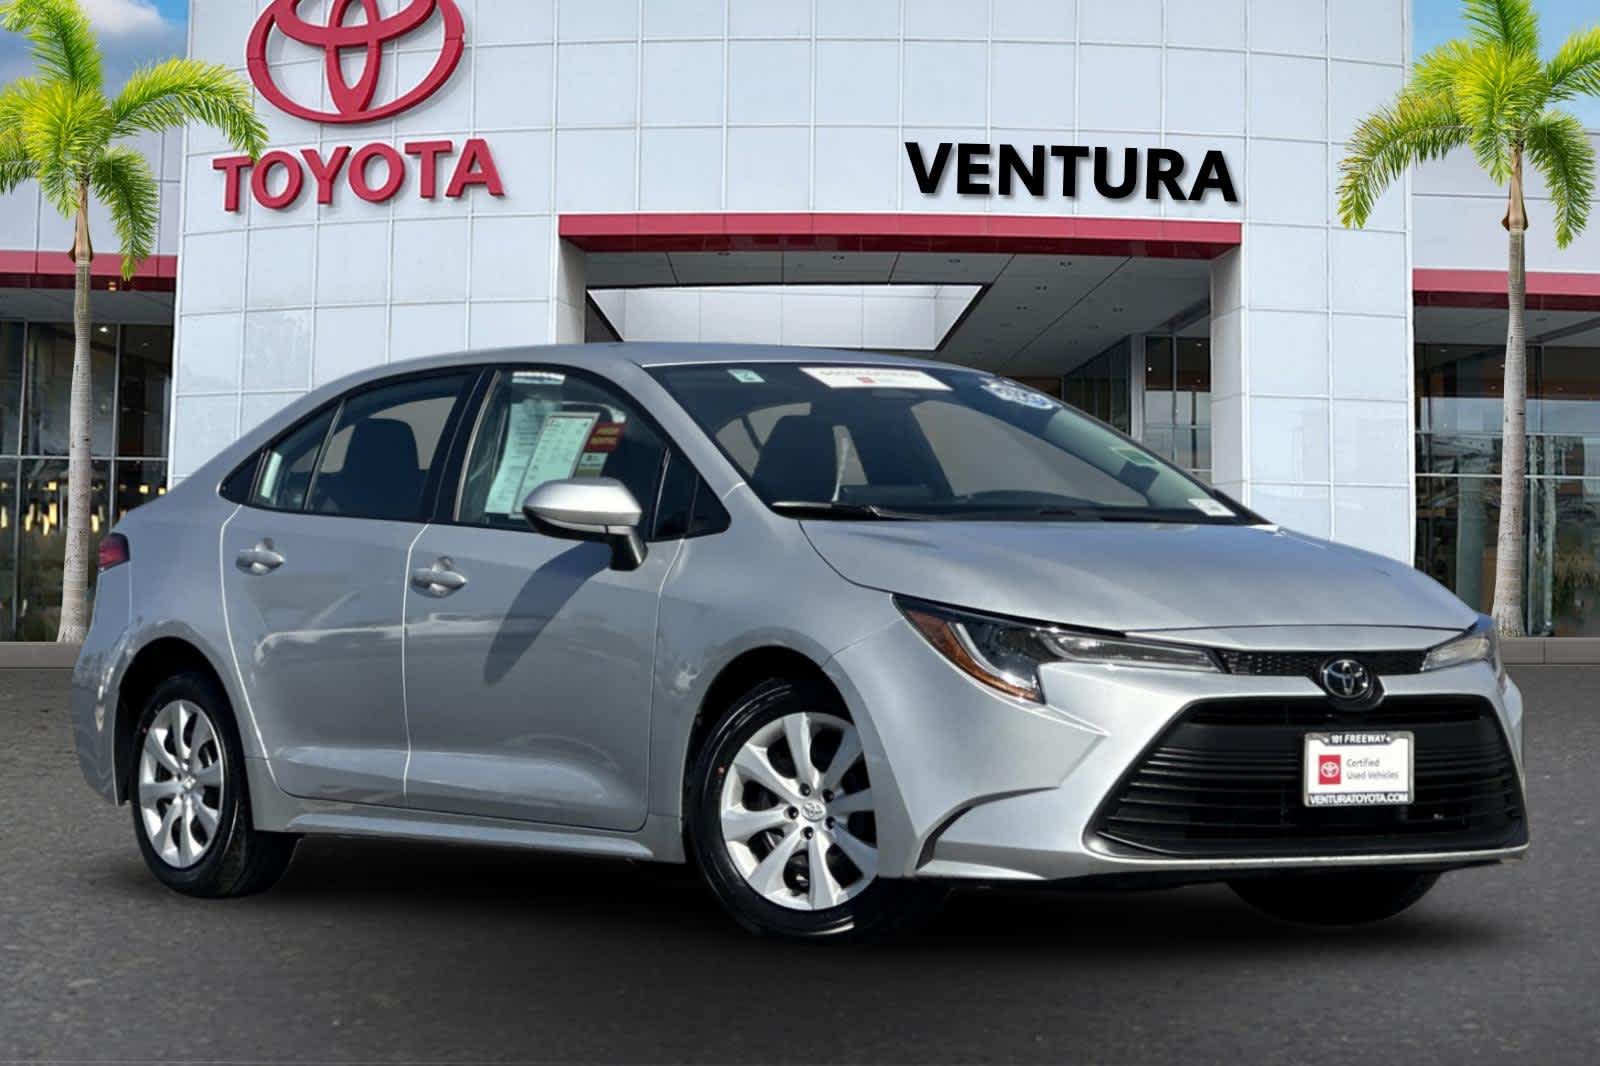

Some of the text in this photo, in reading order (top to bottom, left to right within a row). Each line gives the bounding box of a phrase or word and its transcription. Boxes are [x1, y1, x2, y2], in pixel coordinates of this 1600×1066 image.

[213, 138, 505, 212] TOYOTA
[905, 142, 1238, 203] VENTURA
[1331, 734, 1386, 744] 101 FREEWAY
[1346, 758, 1380, 768] Certified
[1347, 770, 1399, 780] Used Vehicles
[1310, 793, 1409, 804] VENTURATOYOTA.COM
